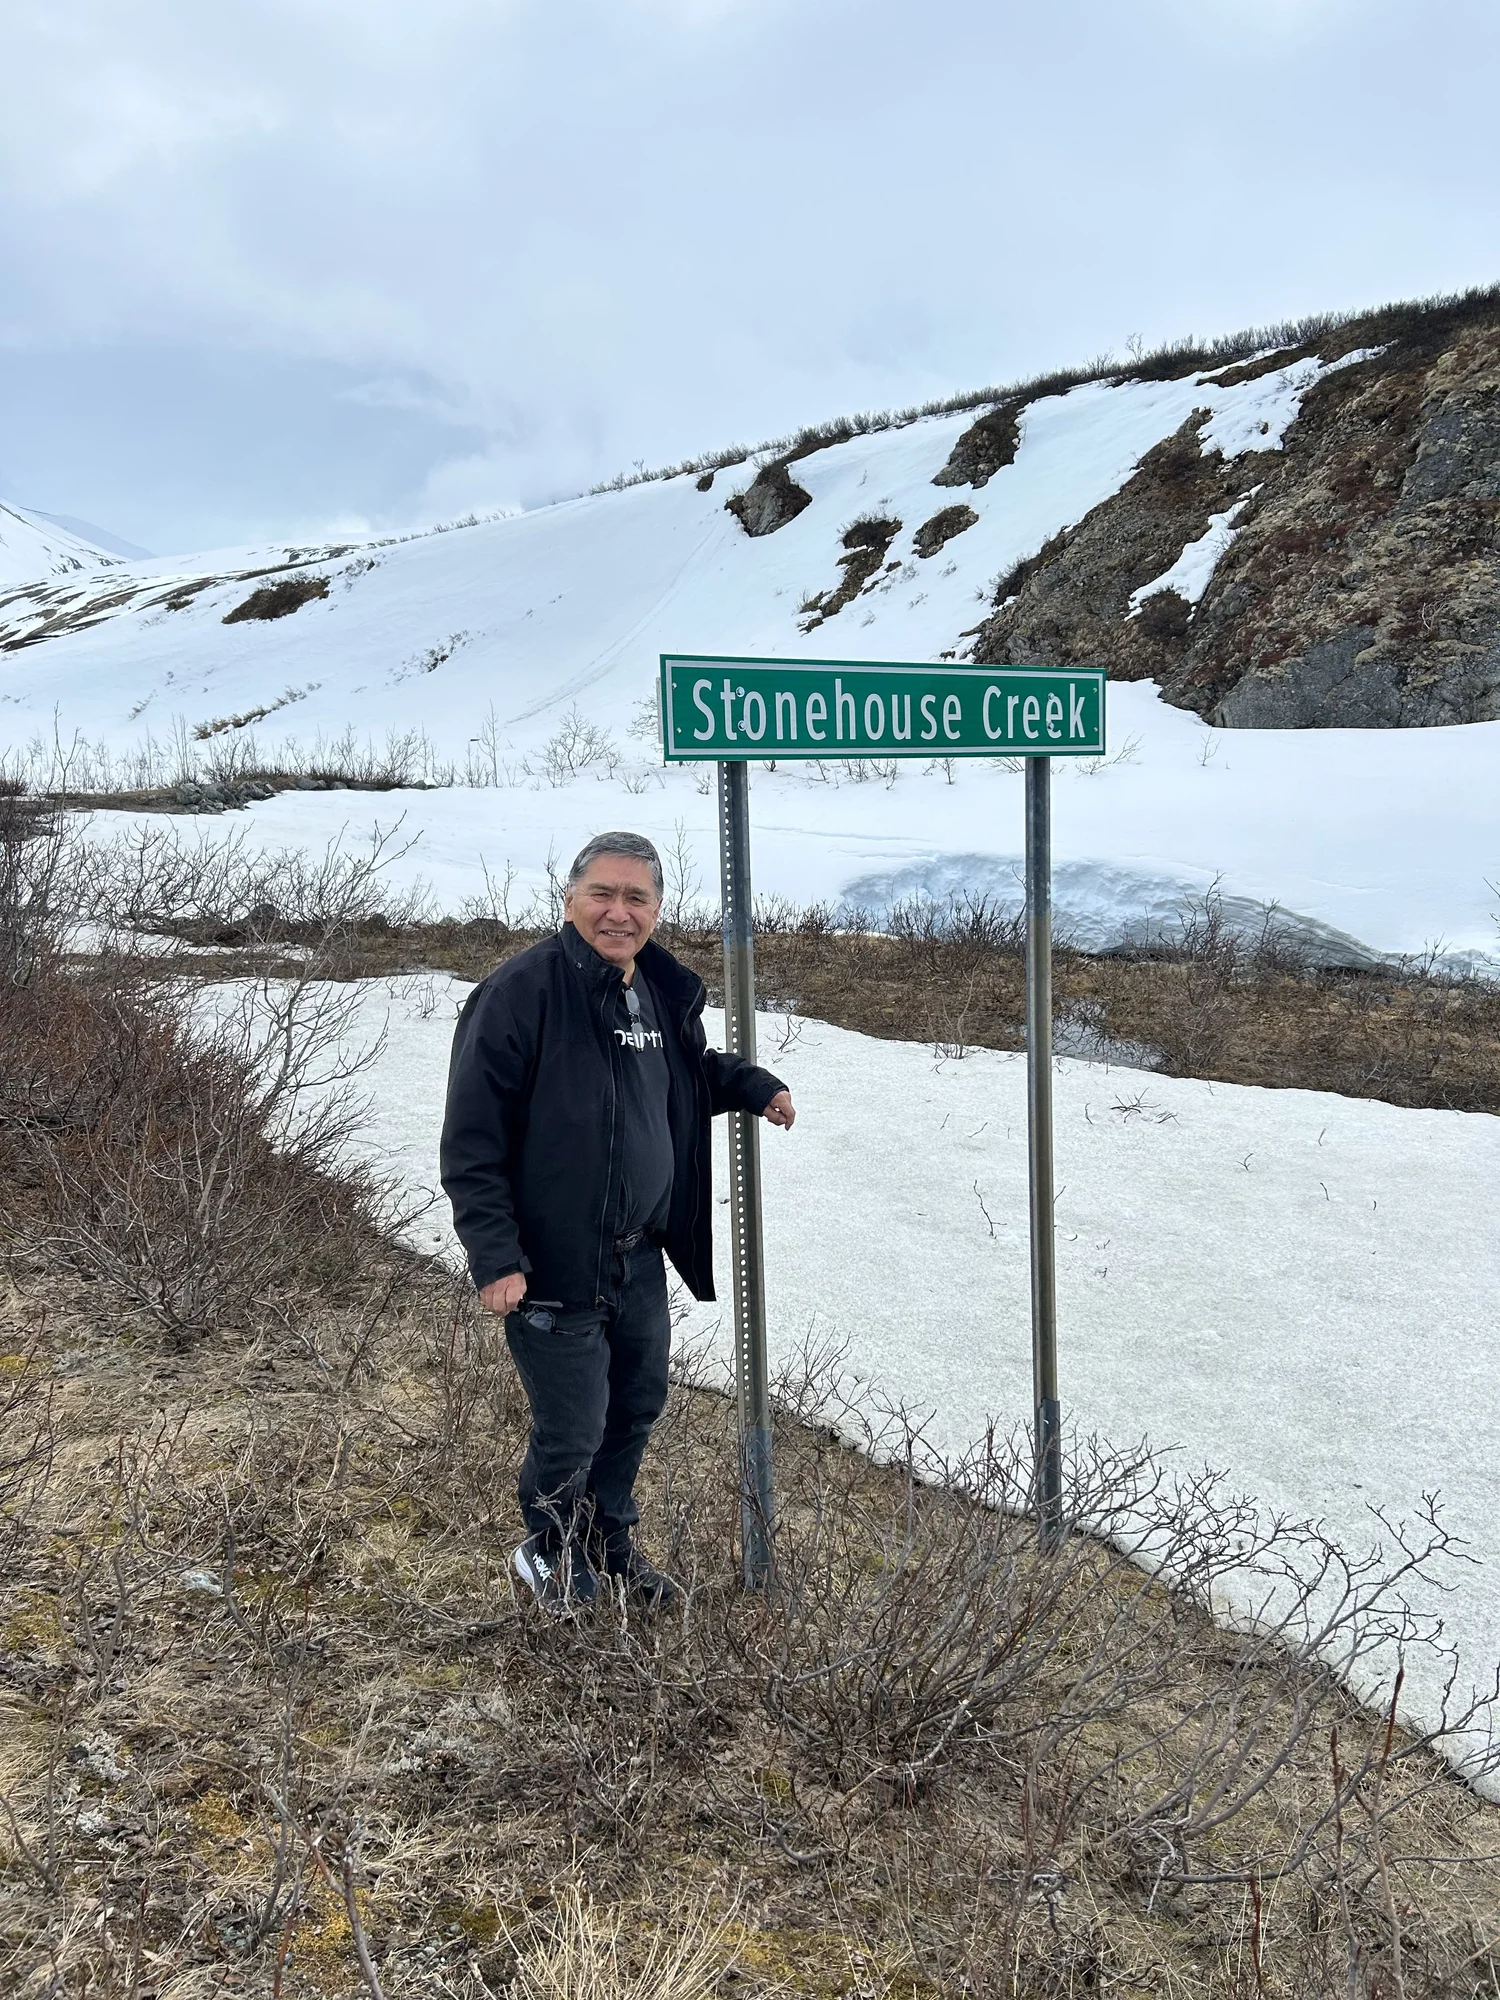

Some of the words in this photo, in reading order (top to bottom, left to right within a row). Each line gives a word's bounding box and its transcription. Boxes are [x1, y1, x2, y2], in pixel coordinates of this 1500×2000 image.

[693, 678, 962, 741] Stonehouse
[982, 683, 1086, 740] Creek
[532, 1552, 551, 1582] HOKA
